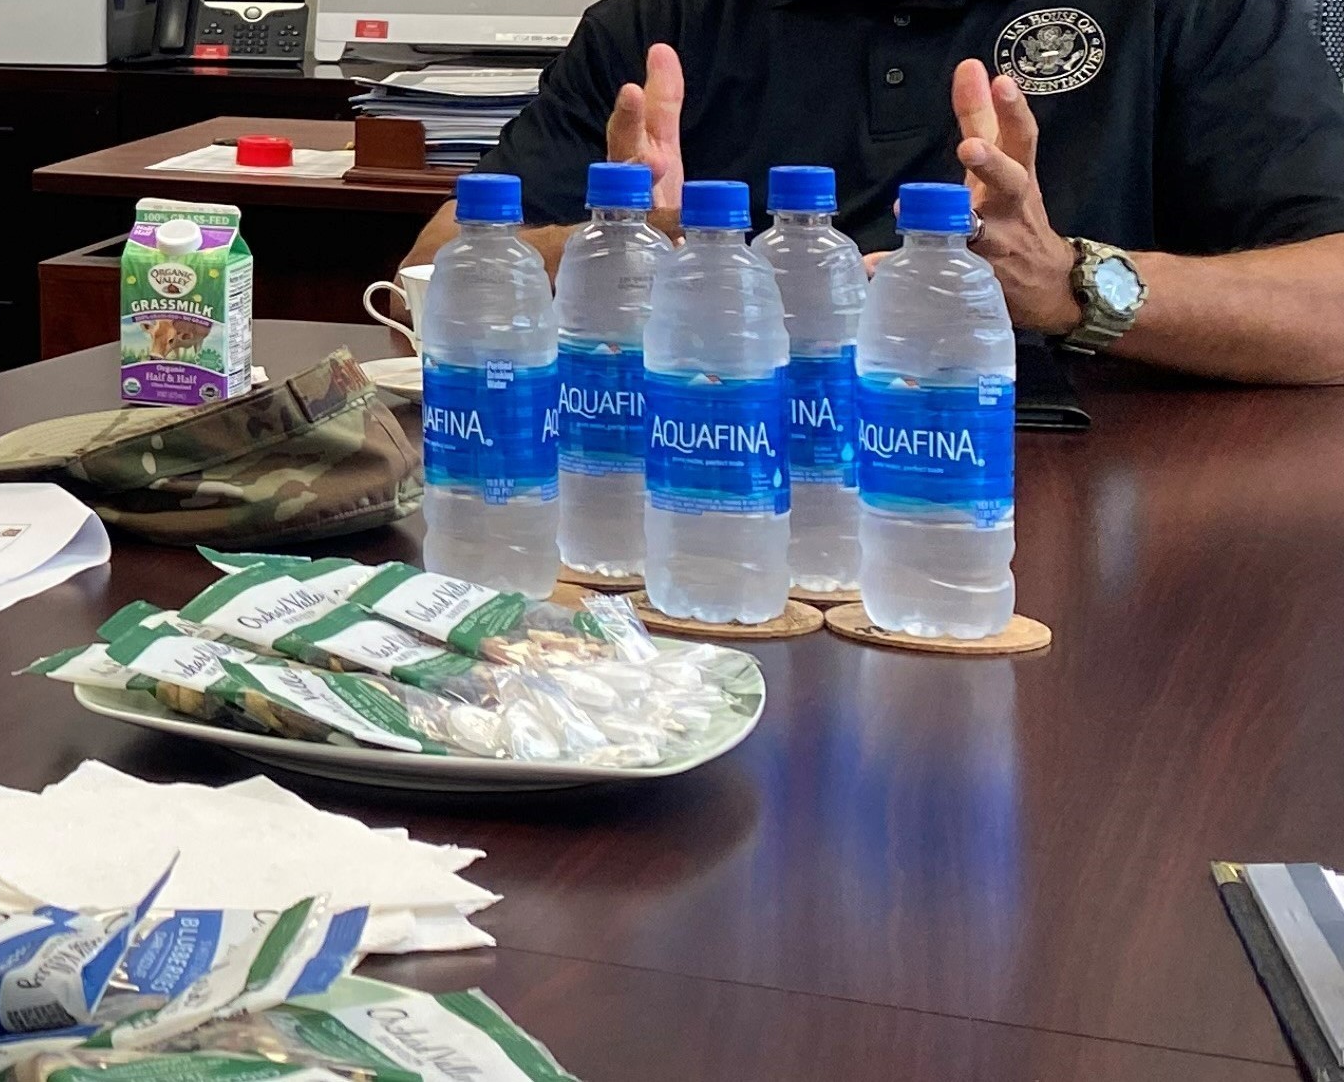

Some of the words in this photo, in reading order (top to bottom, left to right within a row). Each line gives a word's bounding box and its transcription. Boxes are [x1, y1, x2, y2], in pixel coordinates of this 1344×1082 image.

[1028, 12, 1079, 26] HOUSE
[1077, 18, 1097, 35] OF
[150, 268, 193, 282] ORGANIC
[156, 276, 190, 287] VALLEY
[131, 298, 214, 318] GRASSMILK
[145, 372, 166, 381] Half
[176, 375, 198, 385] Half
[559, 383, 646, 419] AQUAFIN
[237, 597, 296, 630] Orchard
[150, 917, 200, 994] BLUEBERRIES
